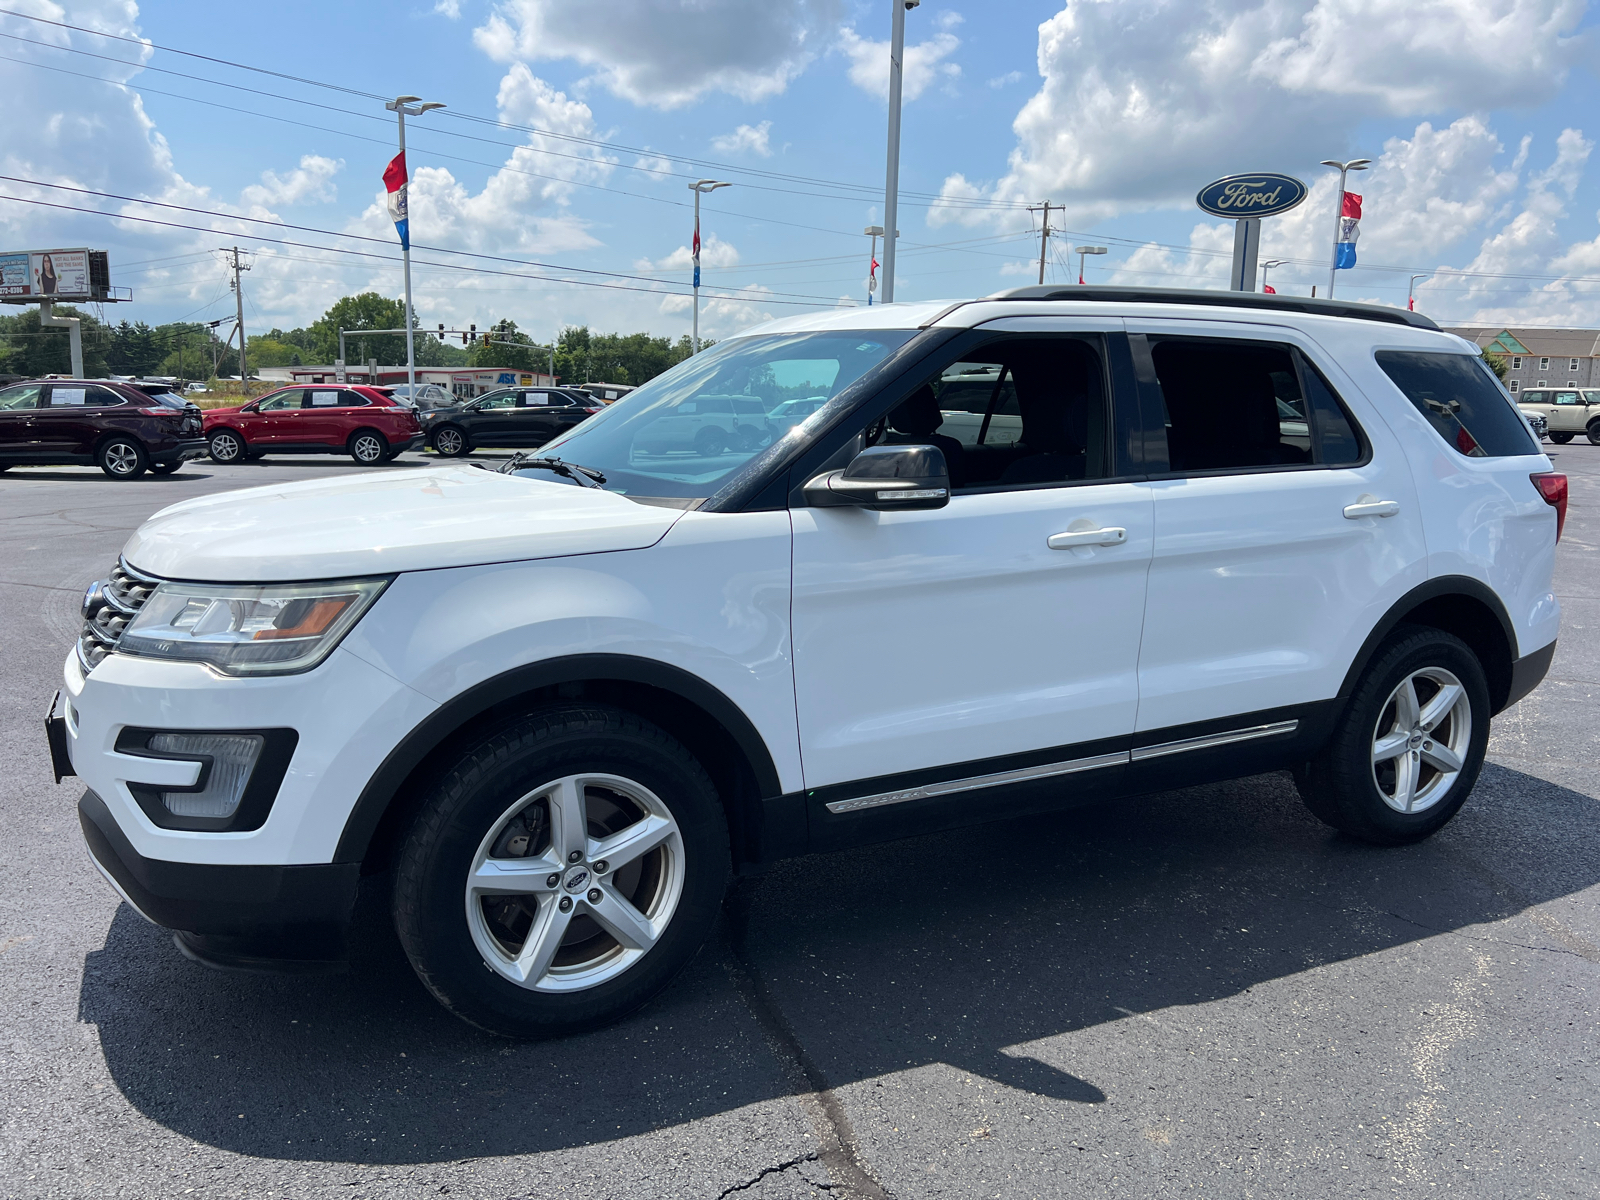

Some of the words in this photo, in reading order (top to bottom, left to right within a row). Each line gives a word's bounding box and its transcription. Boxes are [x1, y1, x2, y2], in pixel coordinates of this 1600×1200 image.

[1217, 181, 1283, 209] Ford
[497, 372, 517, 384] ASK
[570, 873, 585, 887] Ford
